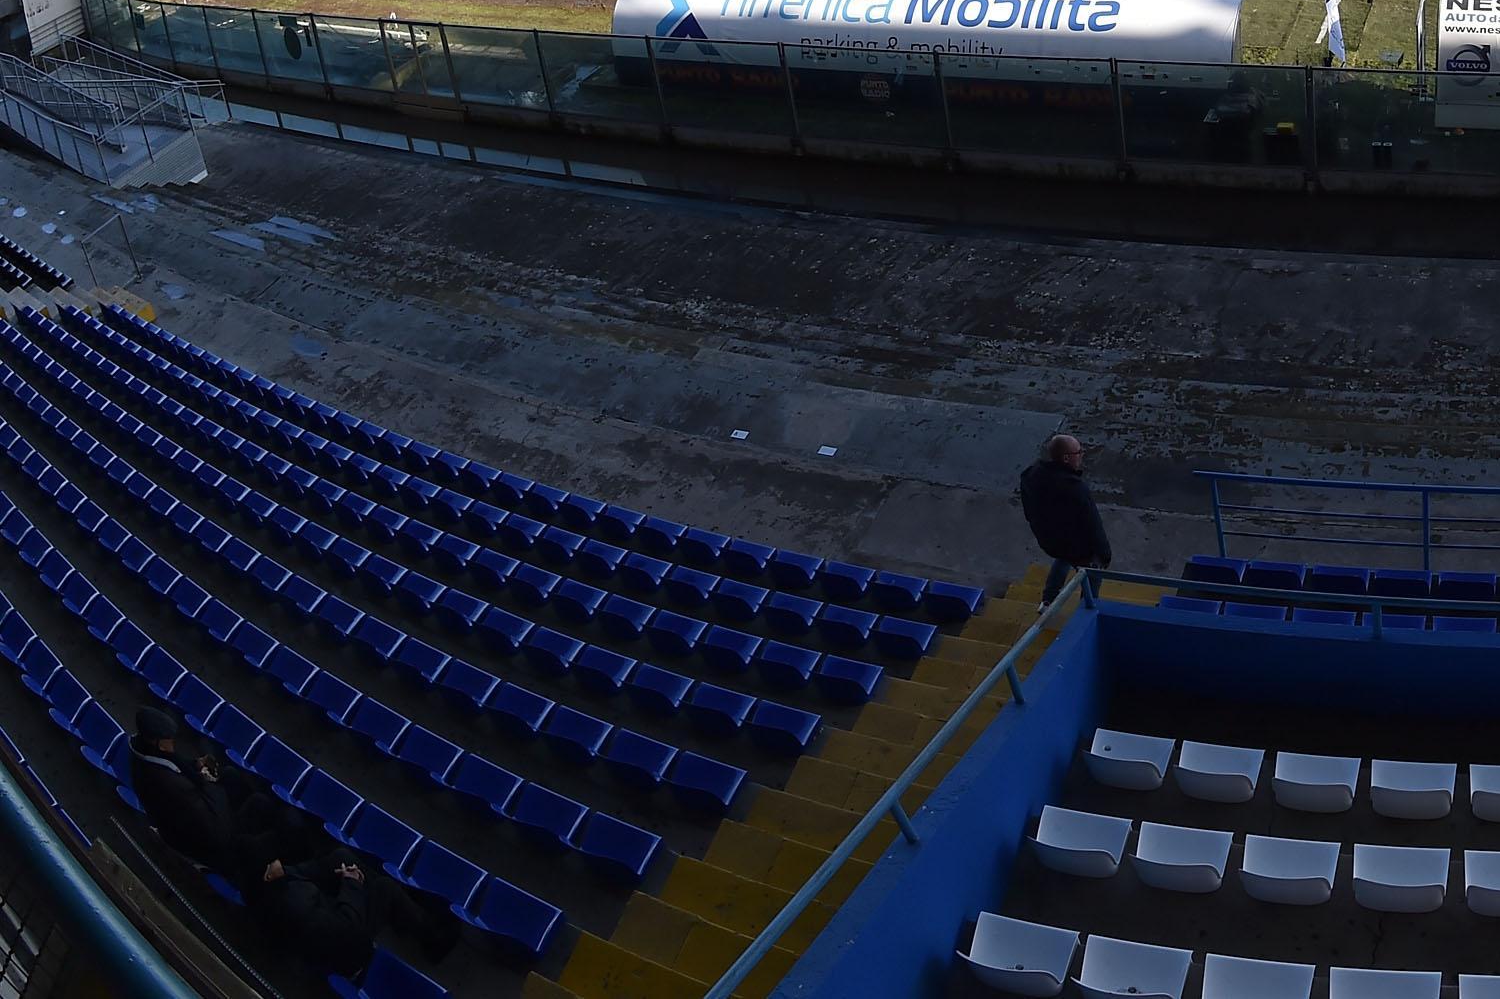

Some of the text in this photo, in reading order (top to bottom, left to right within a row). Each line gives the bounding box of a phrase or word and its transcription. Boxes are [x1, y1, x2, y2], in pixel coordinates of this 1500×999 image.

[1445, 13, 1486, 22] AUTO
[800, 34, 878, 64] parking
[908, 38, 1004, 70] mobility
